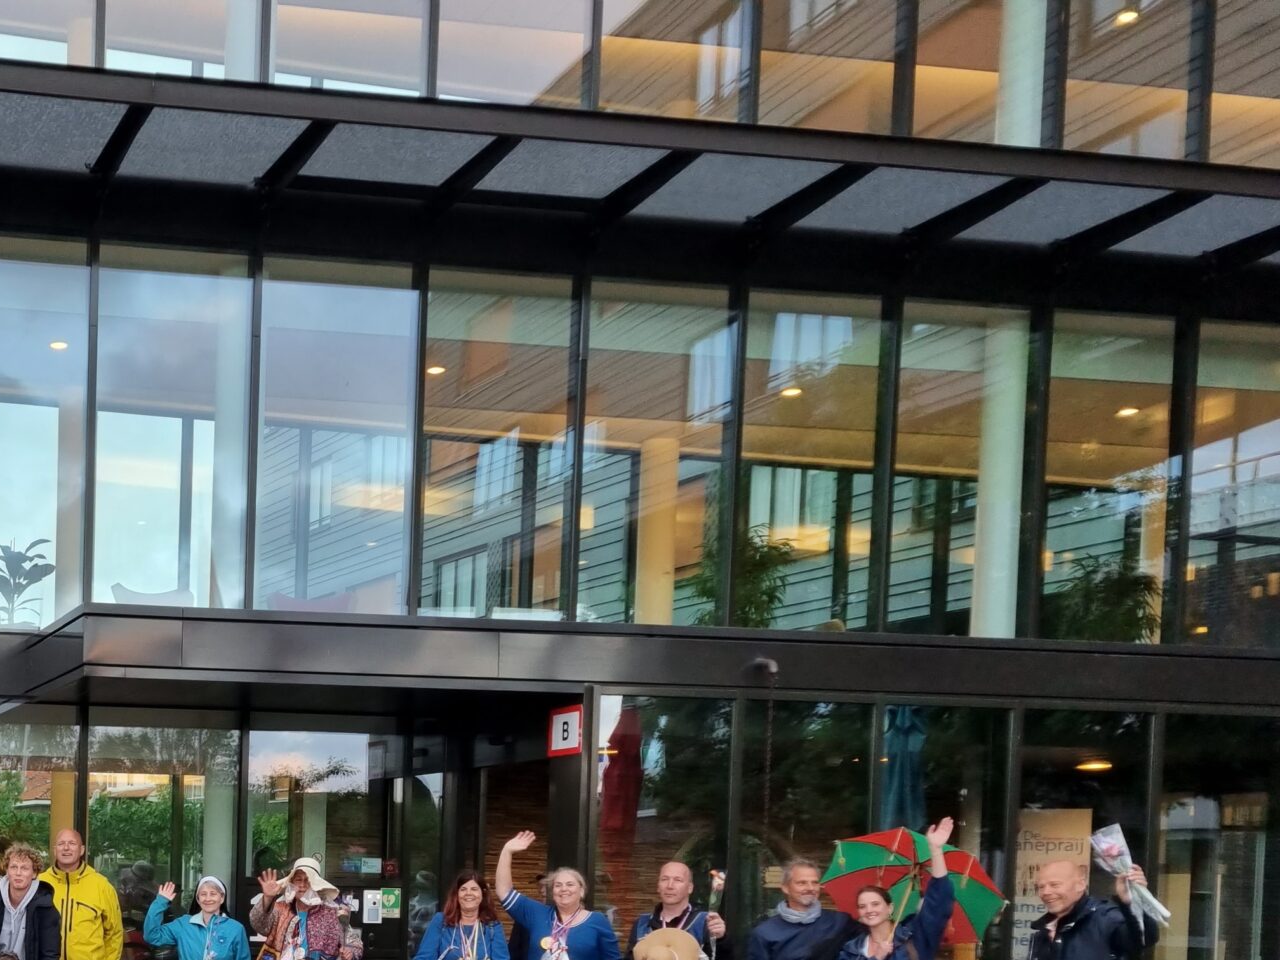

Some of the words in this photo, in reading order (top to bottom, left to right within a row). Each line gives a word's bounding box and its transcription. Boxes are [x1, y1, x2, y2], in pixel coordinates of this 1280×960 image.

[562, 721, 570, 741] B
[1023, 830, 1042, 841] De
[1015, 838, 1084, 856] anepraij
